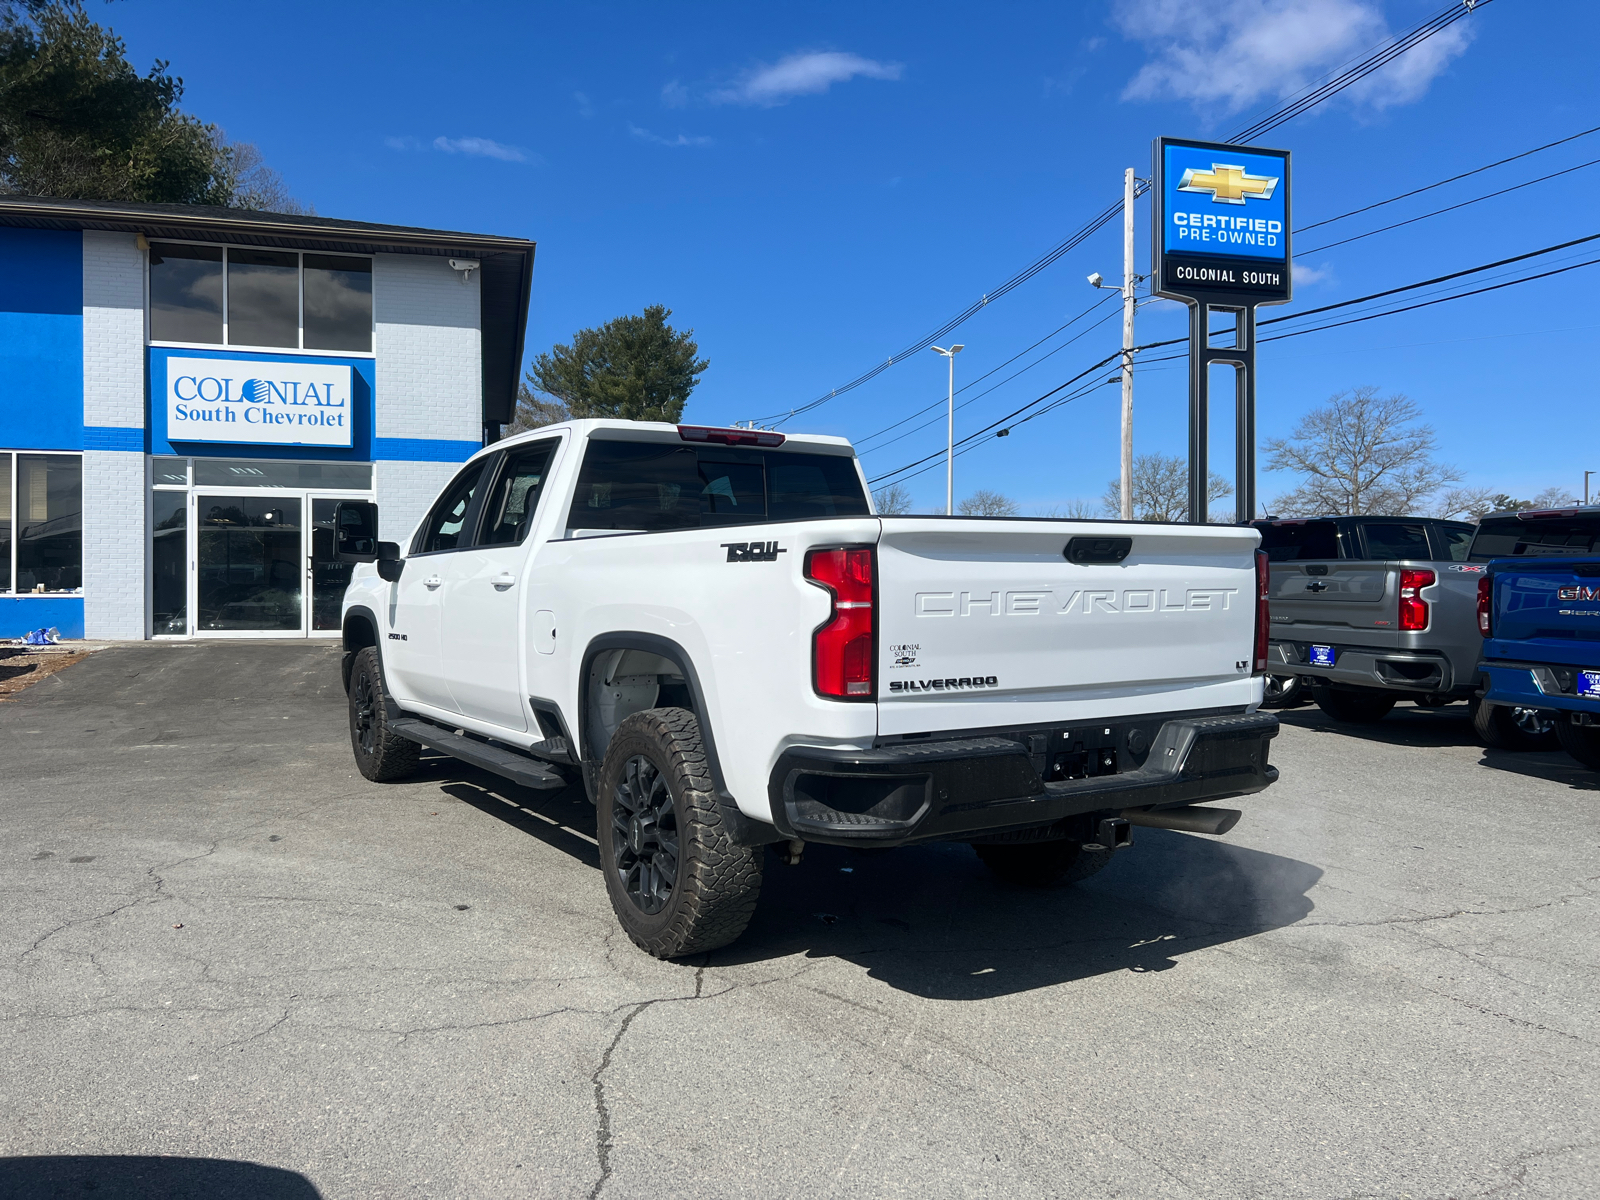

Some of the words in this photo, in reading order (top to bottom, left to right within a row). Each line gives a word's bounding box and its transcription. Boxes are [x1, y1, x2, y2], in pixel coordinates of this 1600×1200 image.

[1174, 212, 1282, 233] CERTIFIED
[1179, 227, 1277, 247] PRE-OWNED
[1177, 266, 1235, 282] COLONIAL
[1242, 271, 1280, 285] SOUTH
[174, 376, 345, 407] COLONIAL
[175, 404, 236, 422] South
[244, 407, 344, 427] Chevrolet
[914, 588, 1239, 618] CHEVROLET
[1236, 661, 1249, 669] LT
[889, 676, 998, 691] SILVERADO
